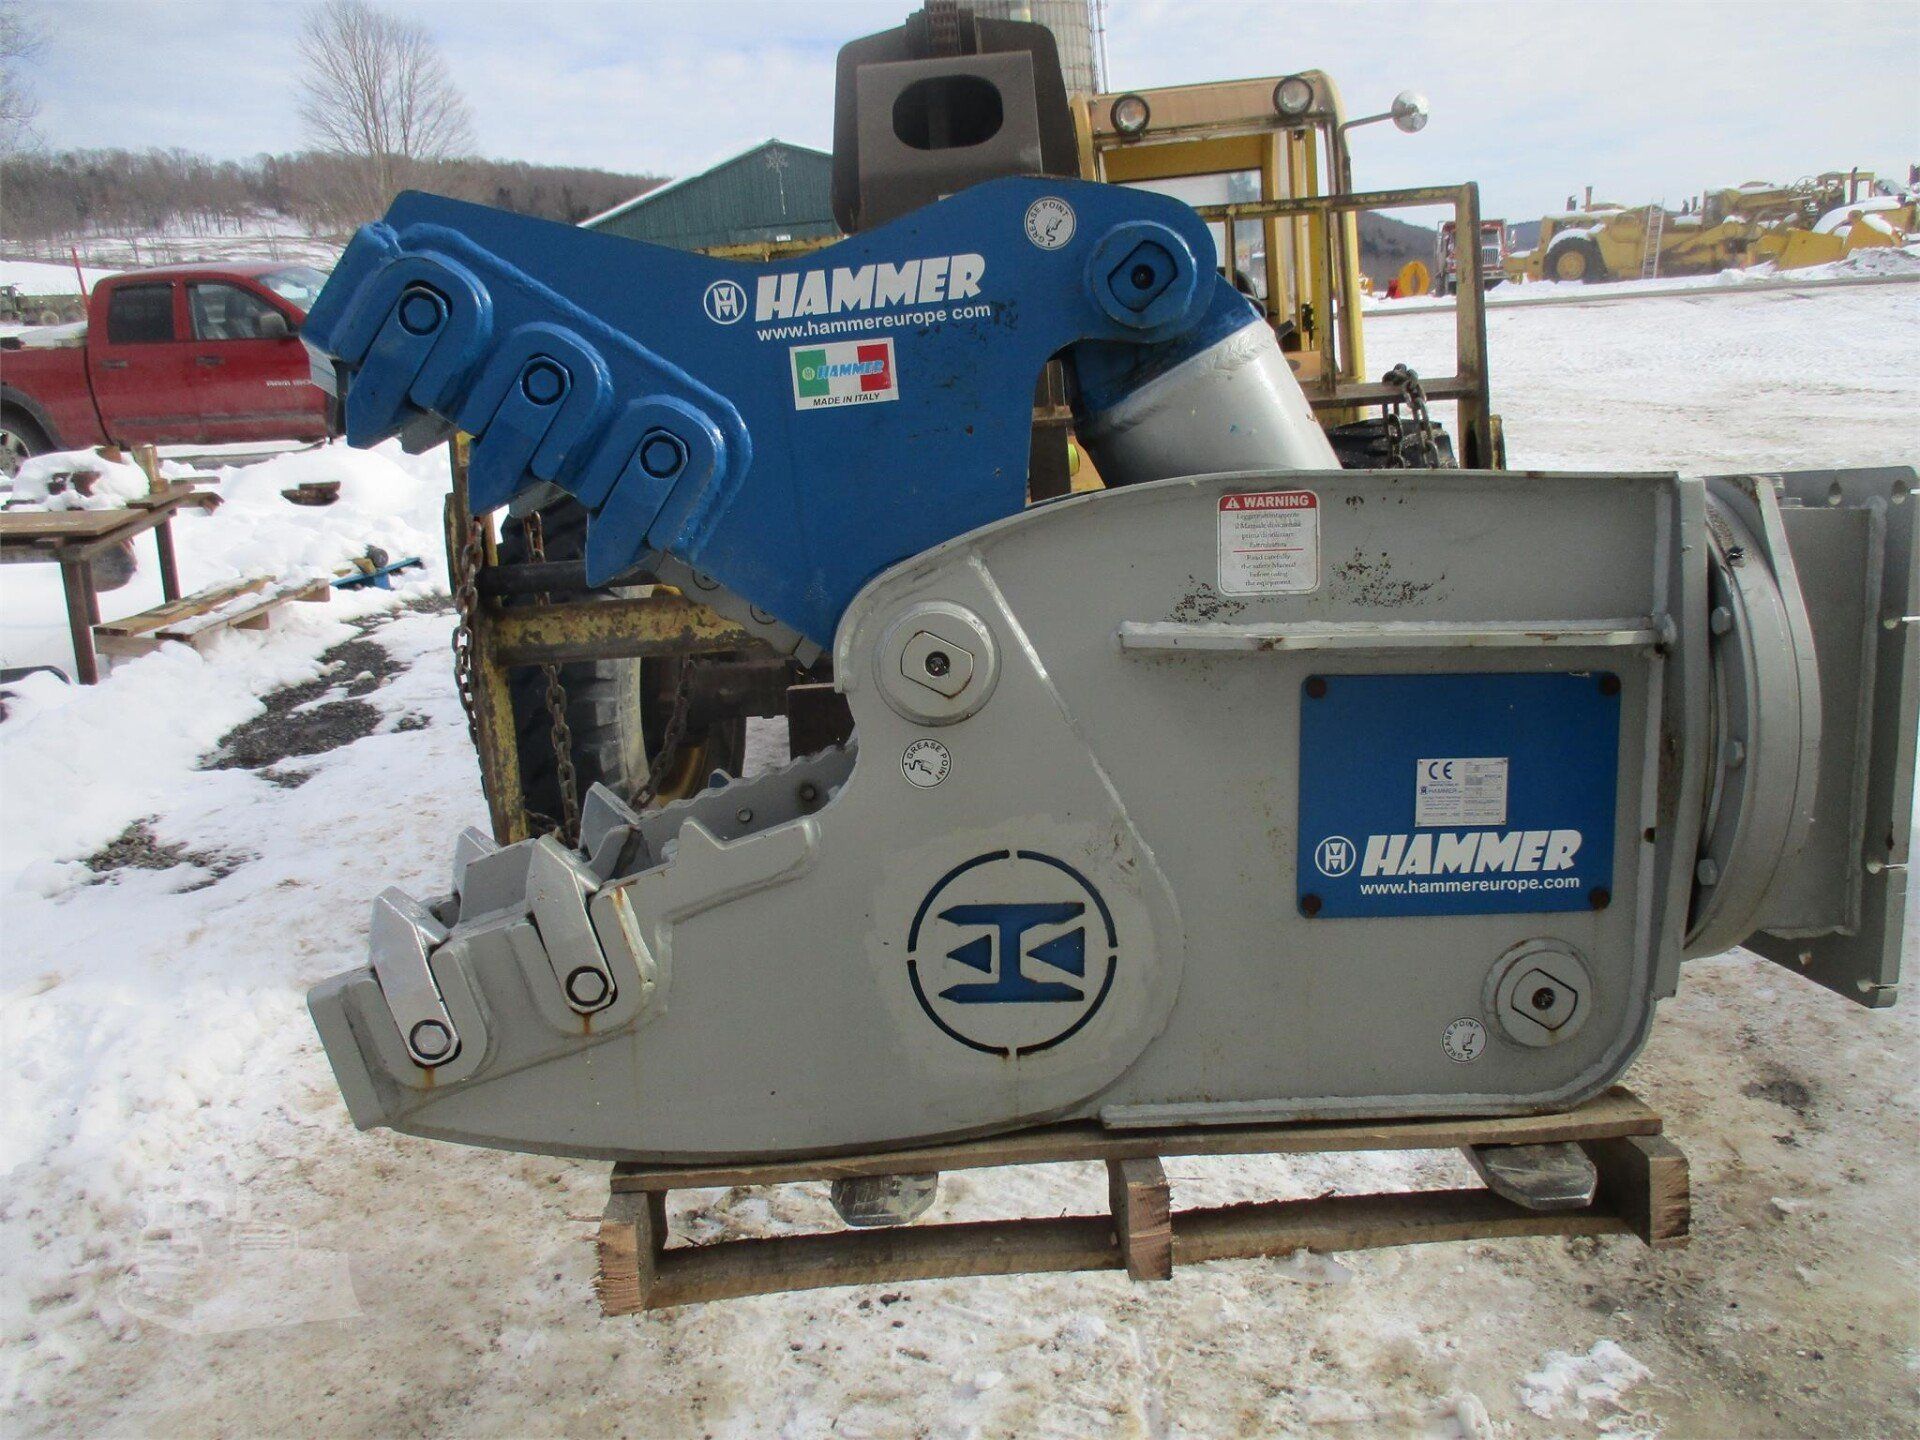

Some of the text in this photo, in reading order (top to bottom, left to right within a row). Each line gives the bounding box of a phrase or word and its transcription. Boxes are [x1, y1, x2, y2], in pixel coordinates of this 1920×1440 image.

[1029, 202, 1069, 242] GREASE POINT
[755, 253, 986, 322] HAMMER
[817, 360, 884, 380] HAMMER
[813, 392, 880, 406] MADE IN ITALY
[1243, 495, 1309, 508] WARNING
[907, 742, 948, 780] GREASE POINT
[1428, 761, 1453, 780] CE
[1360, 830, 1583, 877] HAMMER
[1360, 876, 1580, 895] www.hammereurope.com
